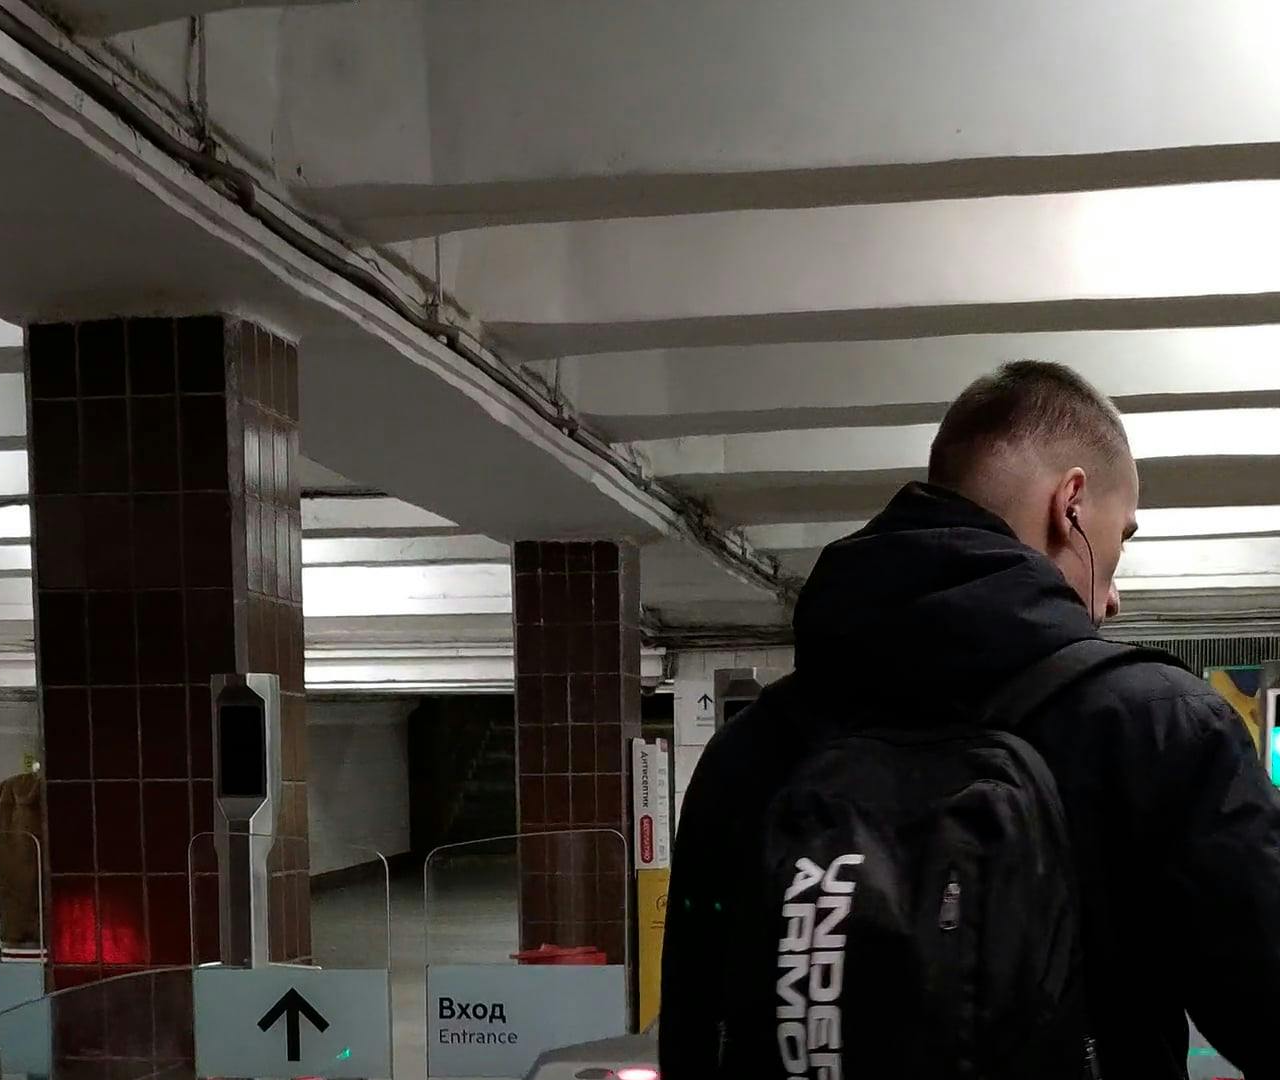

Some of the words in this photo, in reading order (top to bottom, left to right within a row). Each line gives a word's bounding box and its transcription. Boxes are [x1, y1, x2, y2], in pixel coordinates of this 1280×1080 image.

[640, 751, 649, 808] Антисептик
[438, 997, 507, 1024] Вход
[439, 1029, 518, 1044] Entrance
